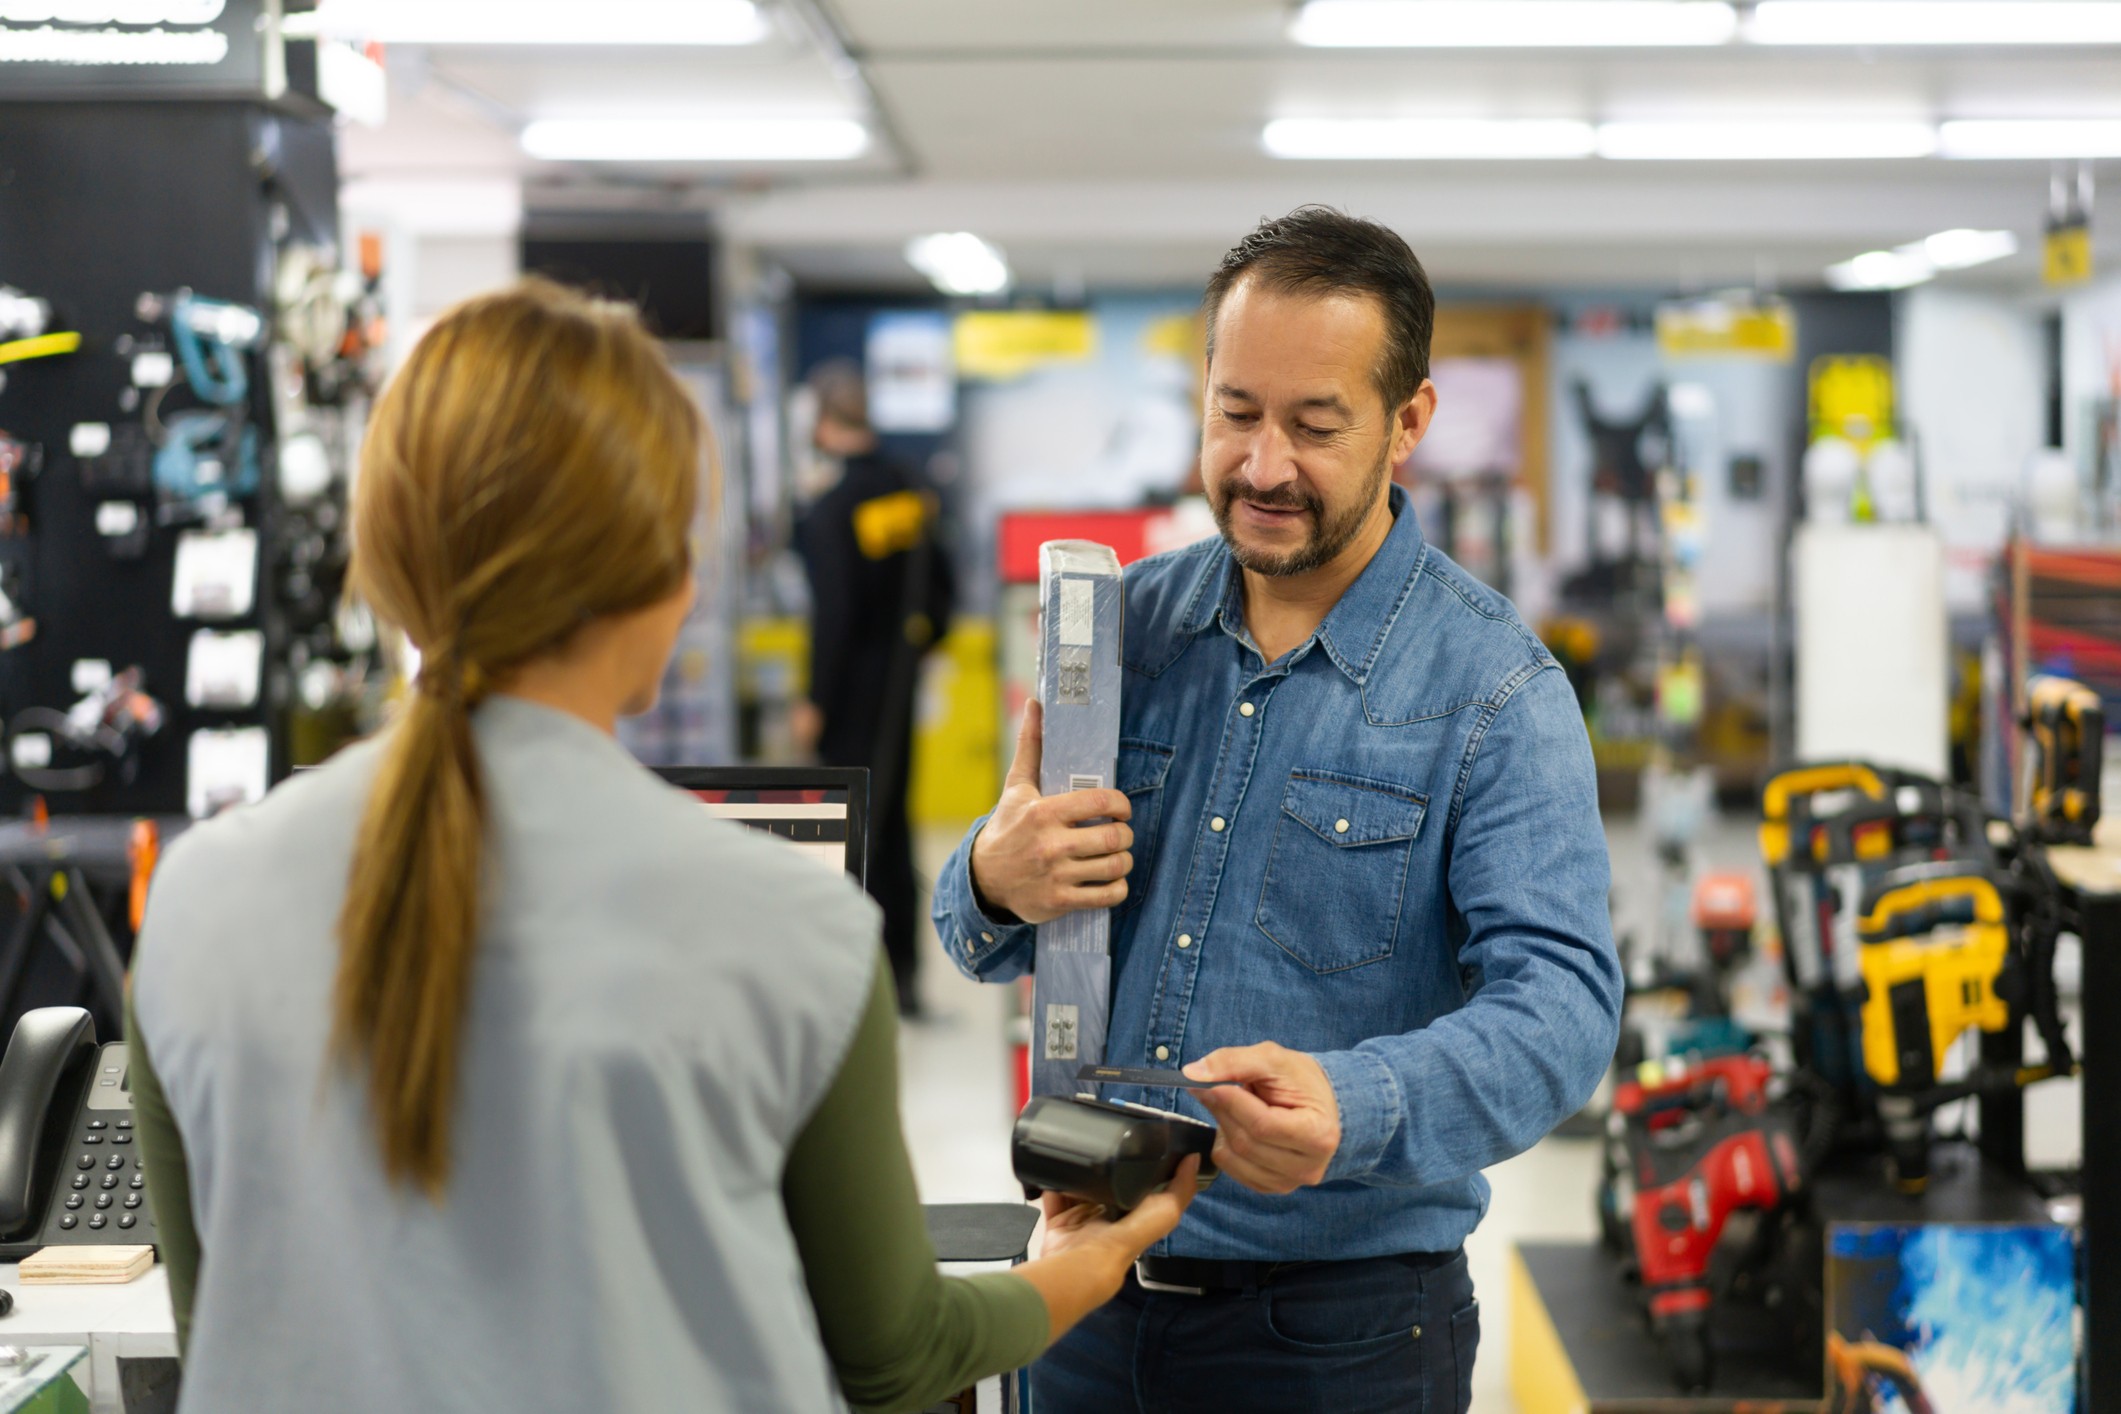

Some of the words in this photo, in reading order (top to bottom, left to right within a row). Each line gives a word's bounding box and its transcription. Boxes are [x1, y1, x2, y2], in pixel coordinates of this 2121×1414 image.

[83, 1154, 89, 1162] 1
[111, 1154, 118, 1162] 2
[99, 1193, 106, 1201] 8
[129, 1193, 136, 1201] 9
[94, 1213, 100, 1221] 0
